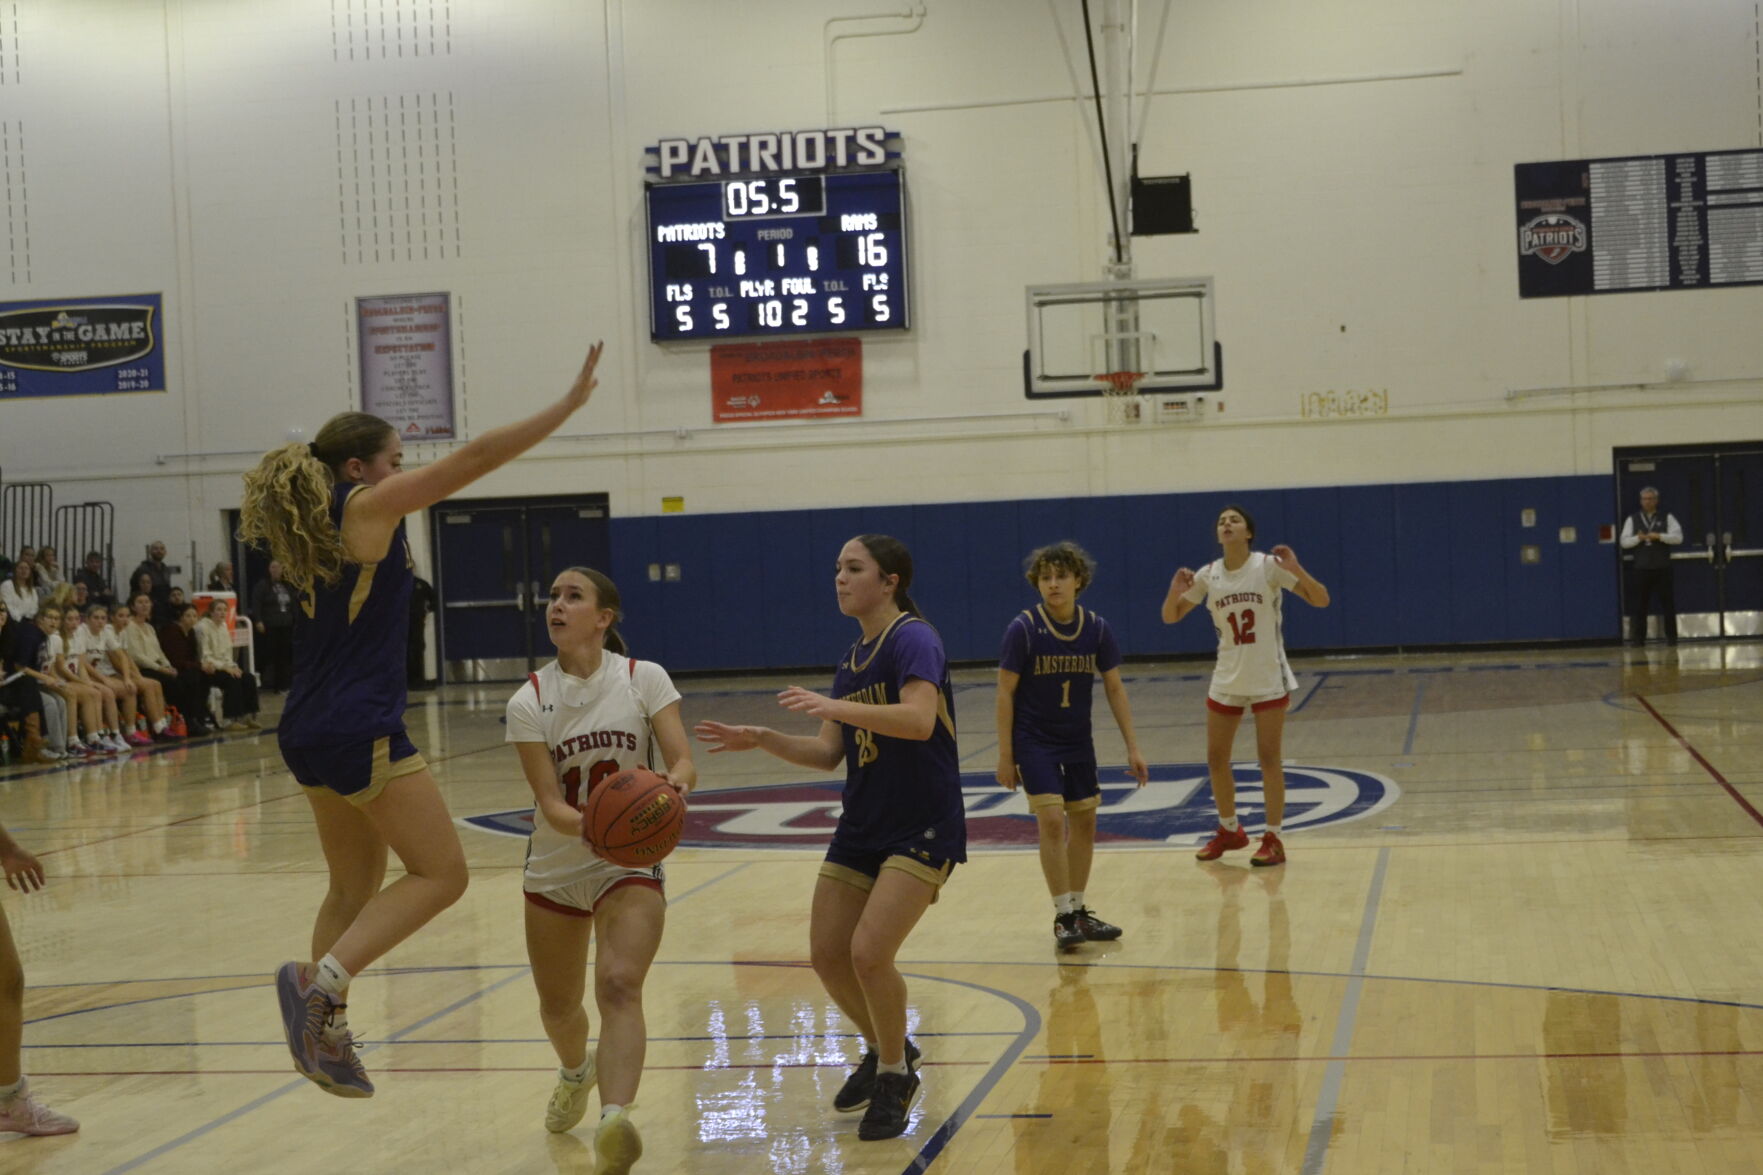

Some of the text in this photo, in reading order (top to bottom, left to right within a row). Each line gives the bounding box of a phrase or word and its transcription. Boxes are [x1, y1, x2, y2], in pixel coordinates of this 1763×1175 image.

[659, 128, 886, 177] PATRIOTS
[727, 179, 799, 215] 05.5
[657, 222, 726, 242] PATRIOTS
[757, 228, 793, 241] PERIOD
[841, 212, 877, 231] RAMS
[858, 233, 888, 267] 16
[1524, 228, 1585, 251] PATRIOTS
[698, 243, 716, 274] 7
[777, 243, 785, 267] 1
[666, 283, 693, 302] FLS
[782, 277, 817, 296] FOUL
[676, 305, 693, 332] 5
[712, 303, 730, 330] 5
[758, 299, 809, 328] 10 2
[828, 297, 846, 324] 5
[872, 294, 890, 321] 5
[52, 332, 60, 341] IN
[62, 331, 75, 341] THE
[77, 322, 145, 341] GAME
[118, 369, 149, 379] 2020-21
[118, 380, 149, 390] 2019-20
[1215, 592, 1263, 610] PATRIOTS
[1227, 609, 1256, 646] 12
[1061, 680, 1071, 708] 1
[855, 728, 878, 768] 25
[628, 798, 675, 837] EGACY
